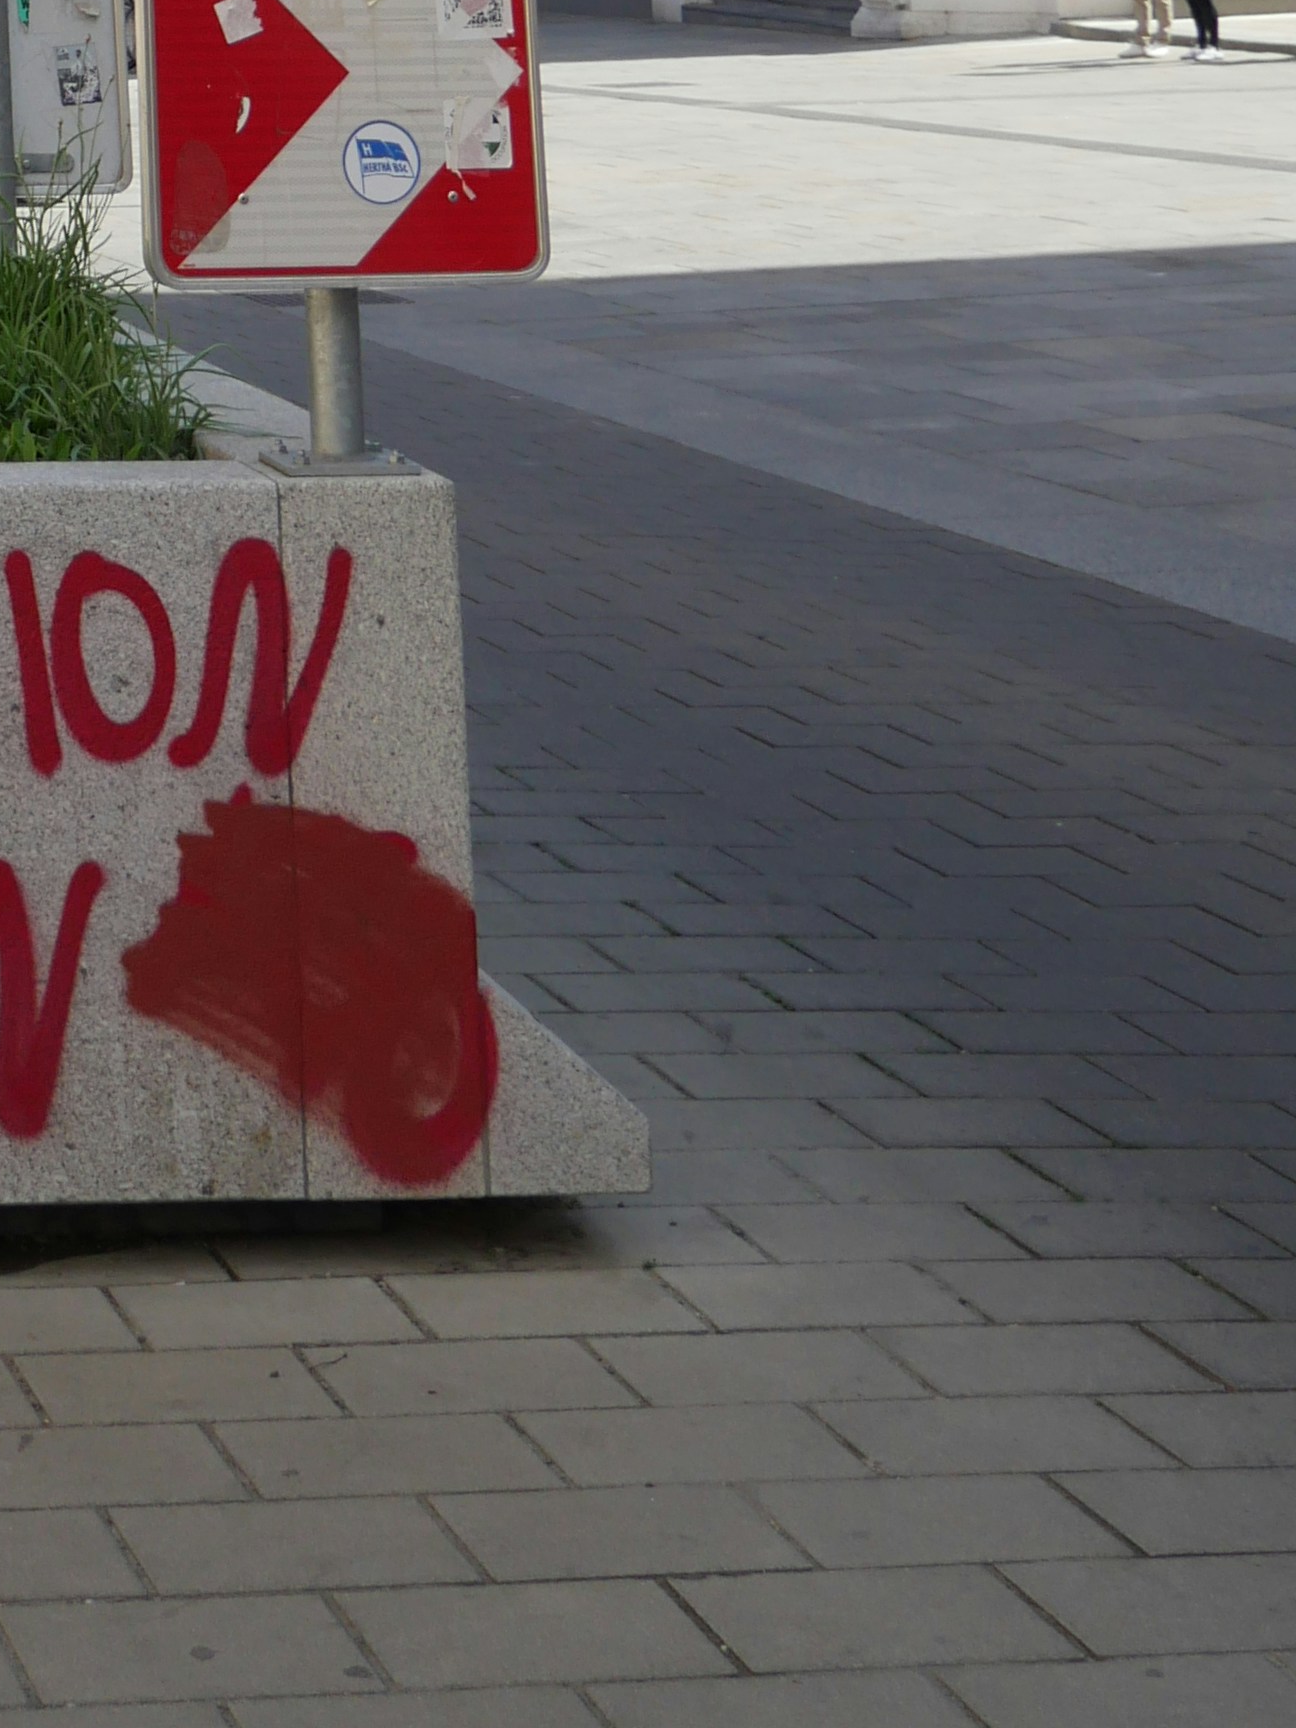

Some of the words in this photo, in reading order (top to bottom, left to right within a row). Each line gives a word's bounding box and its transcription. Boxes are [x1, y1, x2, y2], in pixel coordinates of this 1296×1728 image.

[361, 143, 373, 156] H
[362, 162, 392, 173] HERTHA
[392, 162, 408, 173] BSC
